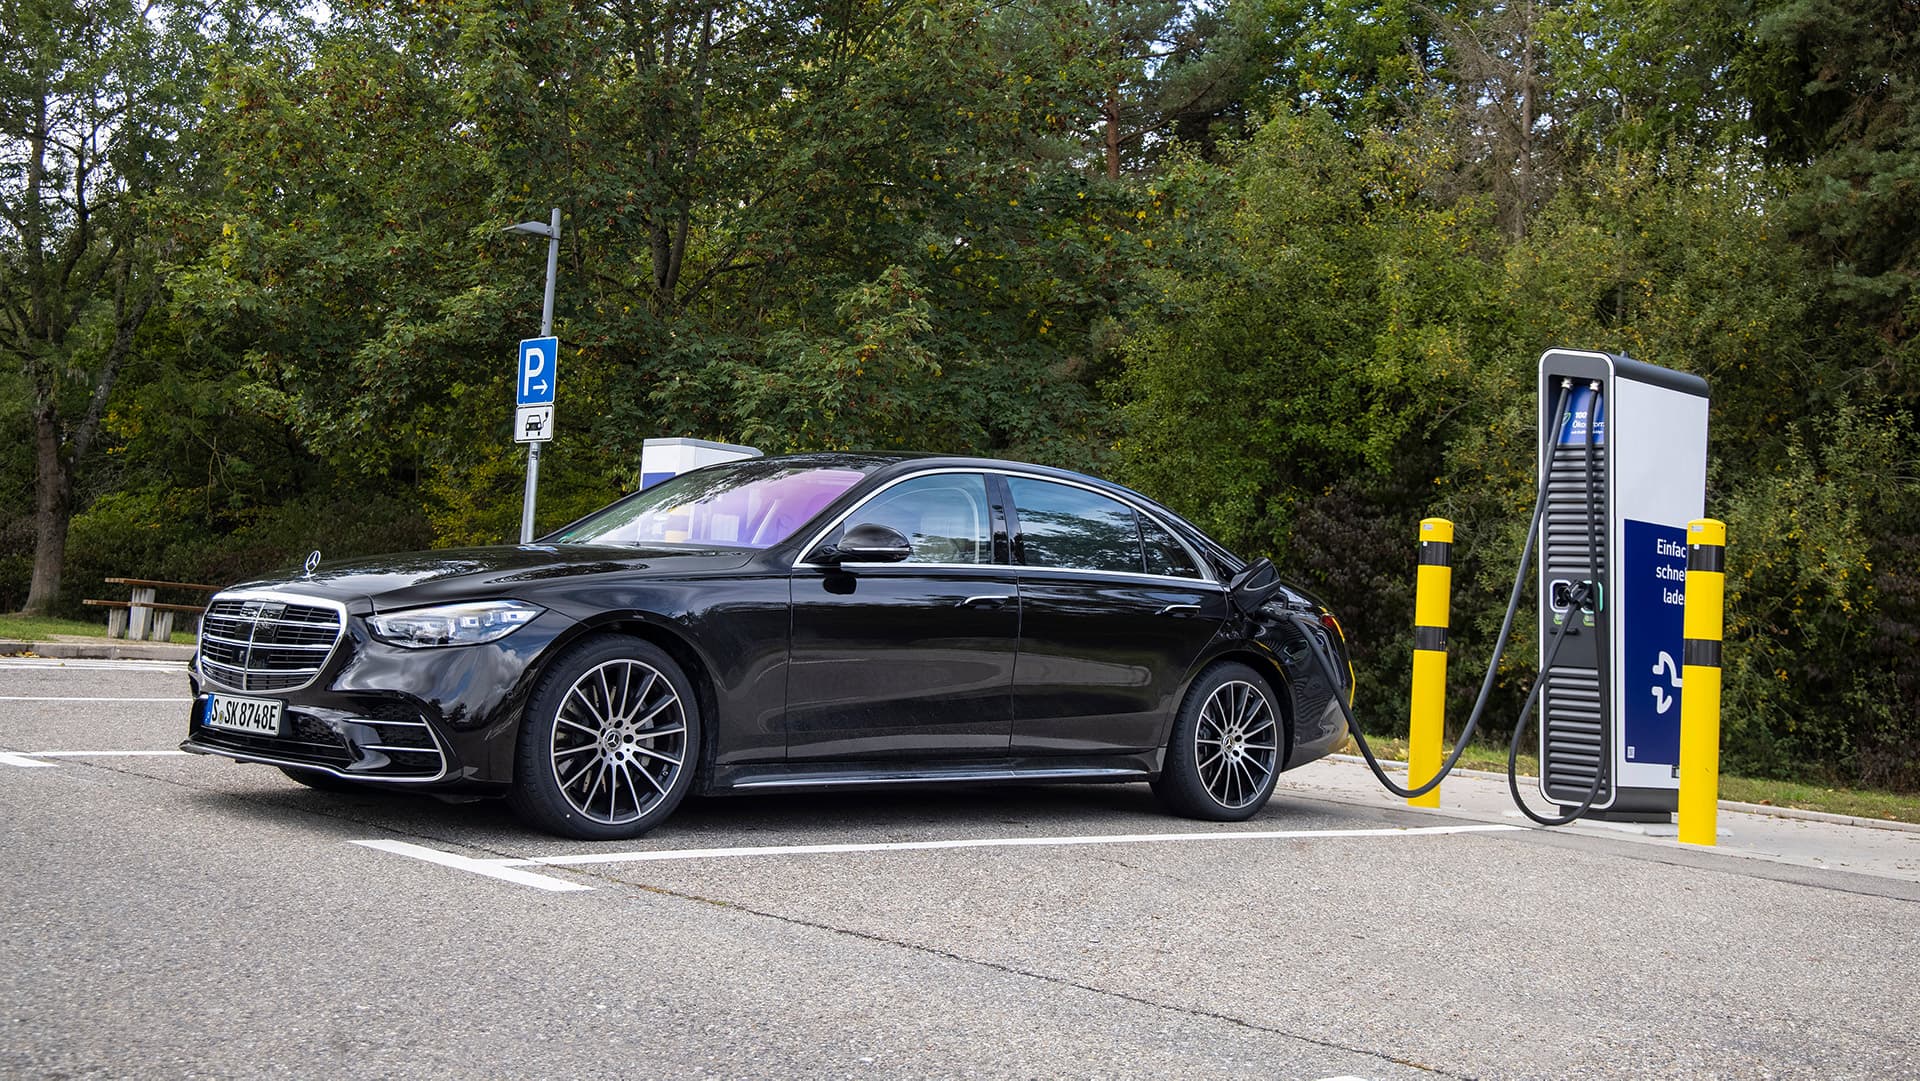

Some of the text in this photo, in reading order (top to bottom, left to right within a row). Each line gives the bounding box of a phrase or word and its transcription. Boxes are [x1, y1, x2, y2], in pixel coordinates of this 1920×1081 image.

[523, 347, 545, 396] P
[1575, 411, 1588, 419] 100
[1656, 538, 1687, 558] Einfac
[1663, 587, 1685, 606] lade
[211, 698, 220, 722] S
